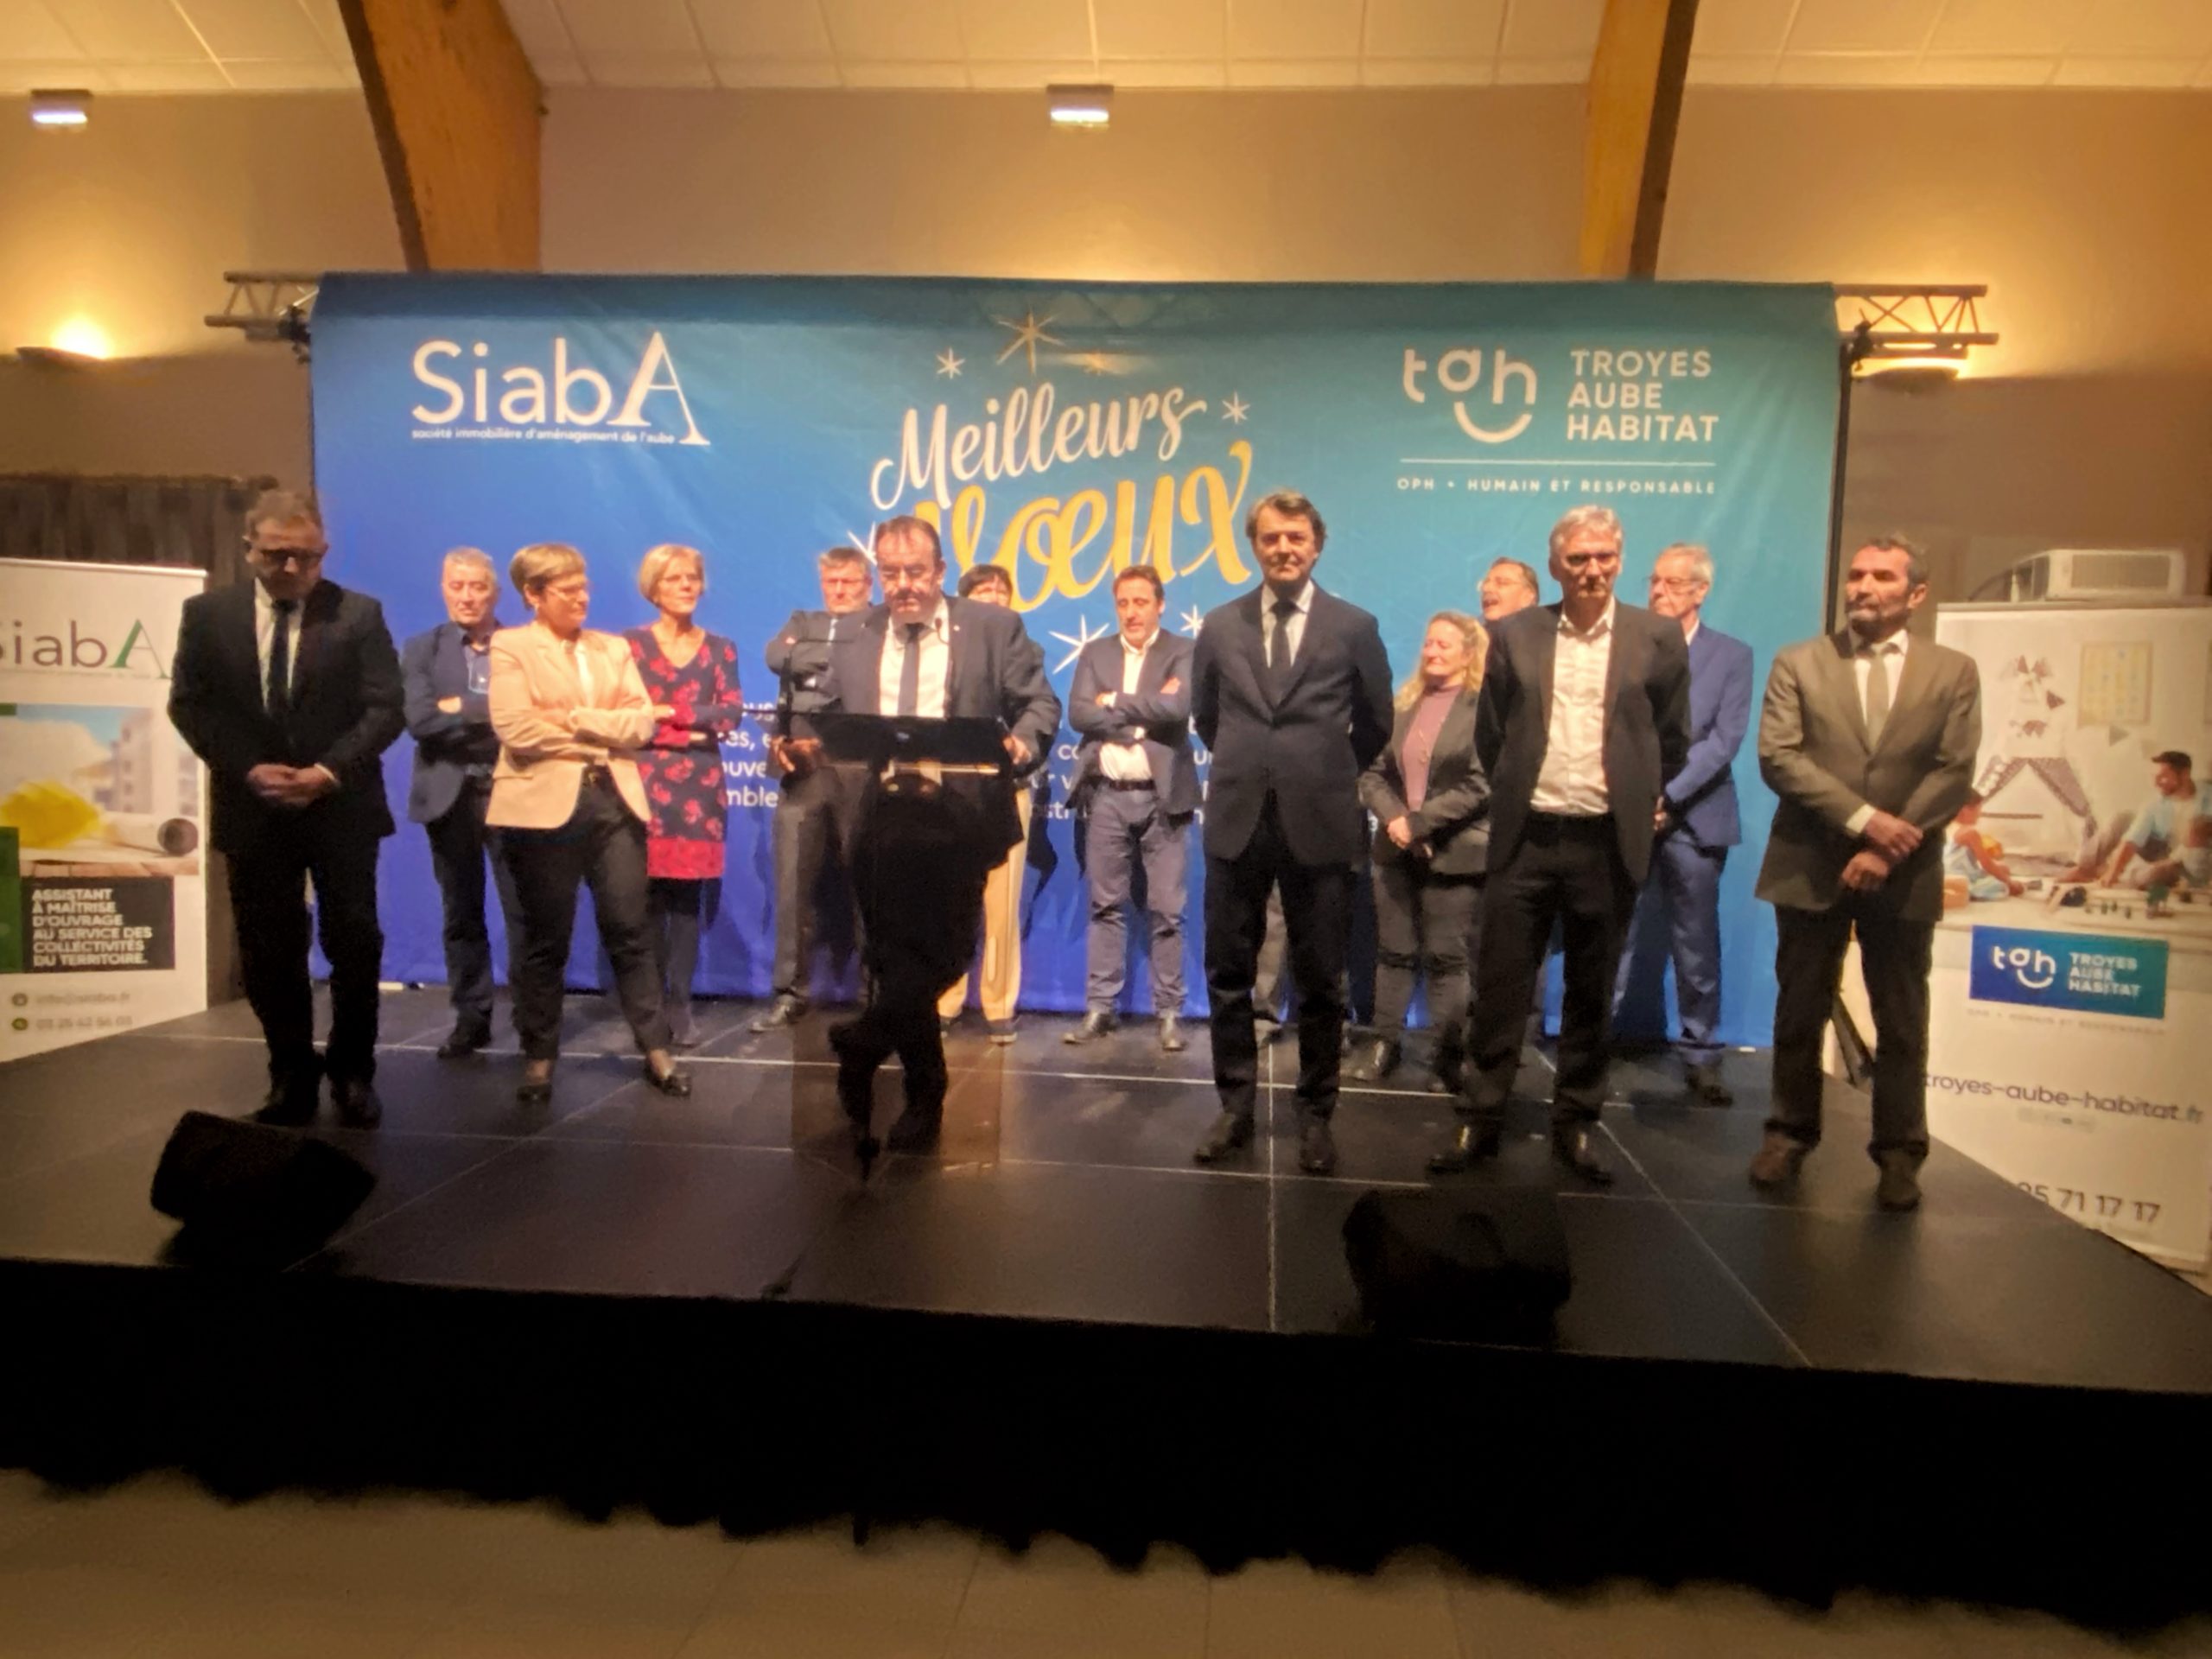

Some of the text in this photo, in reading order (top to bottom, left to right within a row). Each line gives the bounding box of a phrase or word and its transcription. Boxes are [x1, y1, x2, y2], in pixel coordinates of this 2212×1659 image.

[1570, 350, 1713, 378] TROYES
[411, 331, 711, 446] SiabA
[1567, 383, 1663, 409] AUBE
[621, 430, 637, 442] de
[1566, 414, 1719, 442] HABITAT
[869, 382, 1208, 511] Meilleurs
[1396, 478, 1717, 495] OPH HUMAIN ET RESPONSABLE
[0, 619, 173, 680] iabA
[32, 888, 113, 901] ASSISTANT
[32, 914, 124, 927] D'OUVRAGE
[34, 926, 153, 940] AU SERVICE DES
[33, 952, 149, 967] DU TERRITOIRE.
[2069, 952, 2138, 970] TROYES
[2069, 967, 2114, 981] AUBE
[2069, 979, 2141, 996] HABITAT
[2057, 1187, 2085, 1210] 71
[2096, 1194, 2122, 1217] 17
[2133, 1201, 2160, 1224] 17
